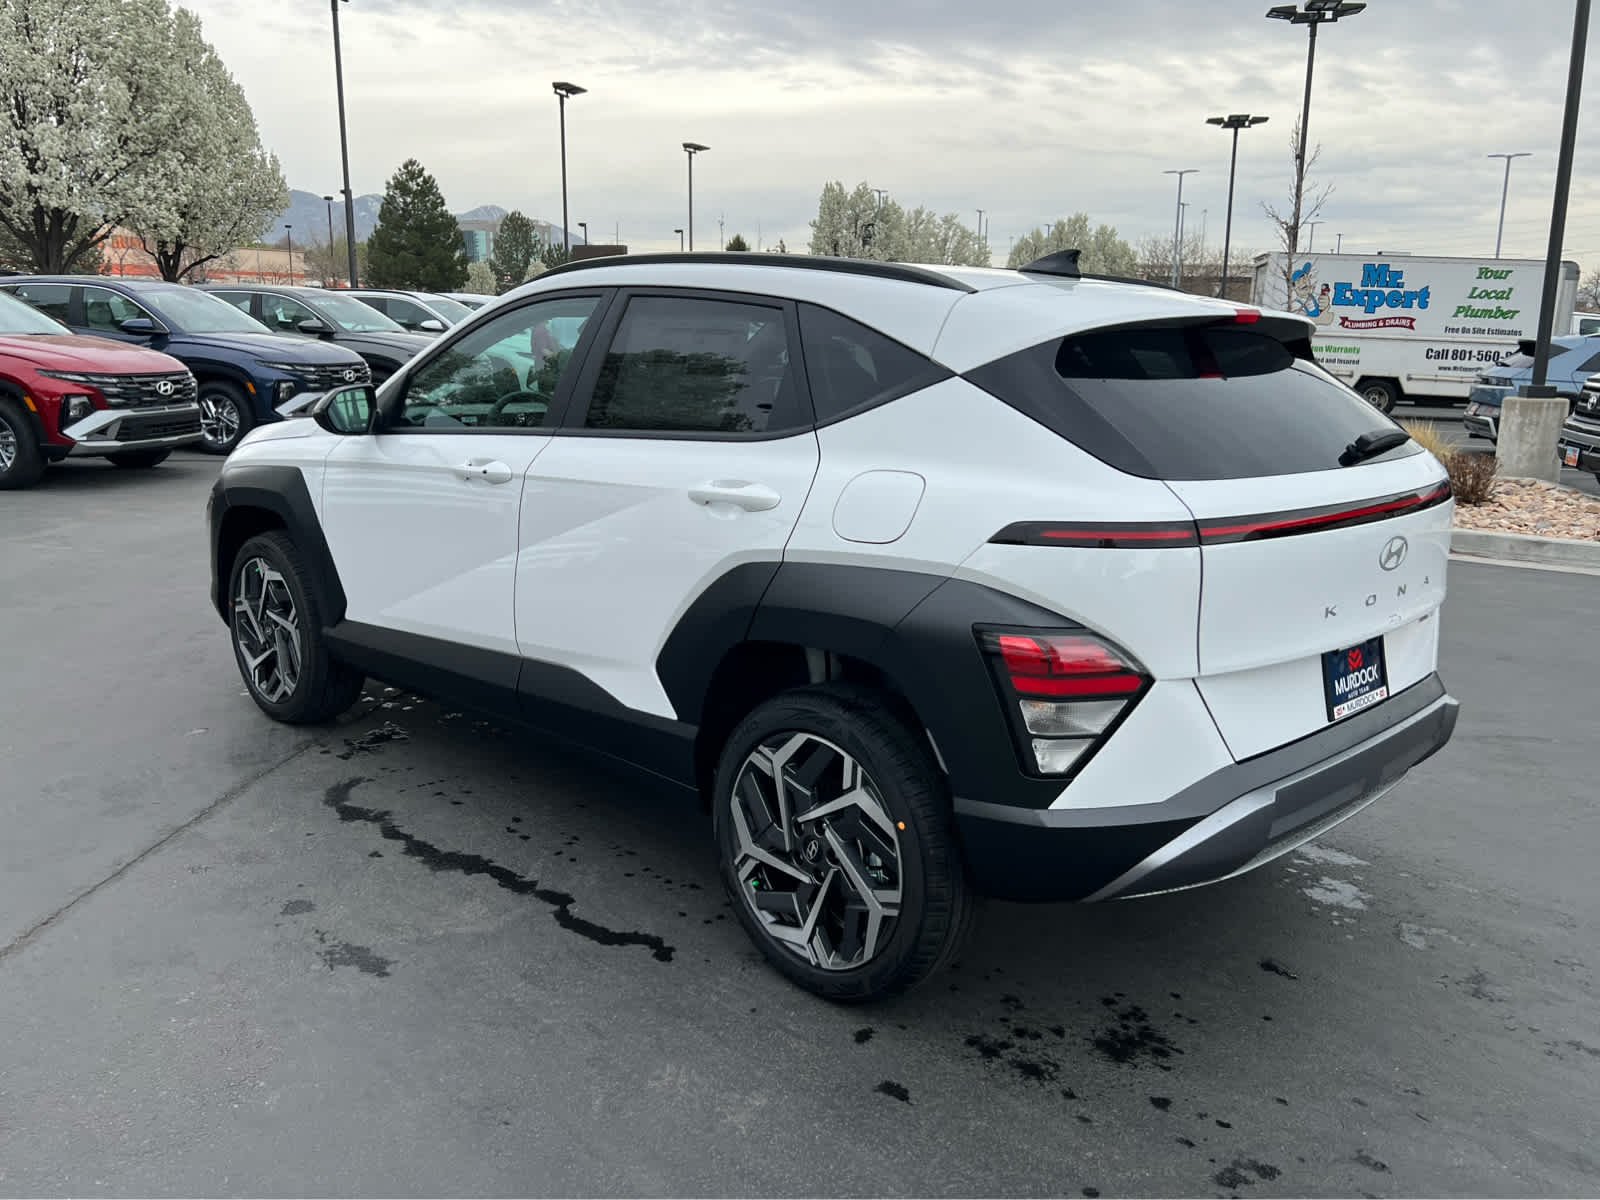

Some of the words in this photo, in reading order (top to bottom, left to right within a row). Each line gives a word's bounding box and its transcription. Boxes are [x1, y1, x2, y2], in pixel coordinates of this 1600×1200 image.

[1361, 263, 1405, 288] Mr.
[1476, 267, 1513, 280] Your
[1332, 282, 1431, 314] Expert
[1467, 286, 1514, 300] Local
[1452, 305, 1520, 319] Plumber
[1344, 320, 1377, 328] PLUMBING
[1379, 319, 1384, 327] &
[1386, 318, 1411, 327] DRAINS
[1444, 326, 1460, 334] Free
[1472, 327, 1486, 335] Site
[1487, 328, 1522, 336] Estimates
[1325, 345, 1360, 354] Warranty
[1426, 348, 1450, 360] Call
[1325, 576, 1429, 618] KONA
[1334, 664, 1378, 696] MURDOCK
[1346, 694, 1376, 712] MURDOCK
